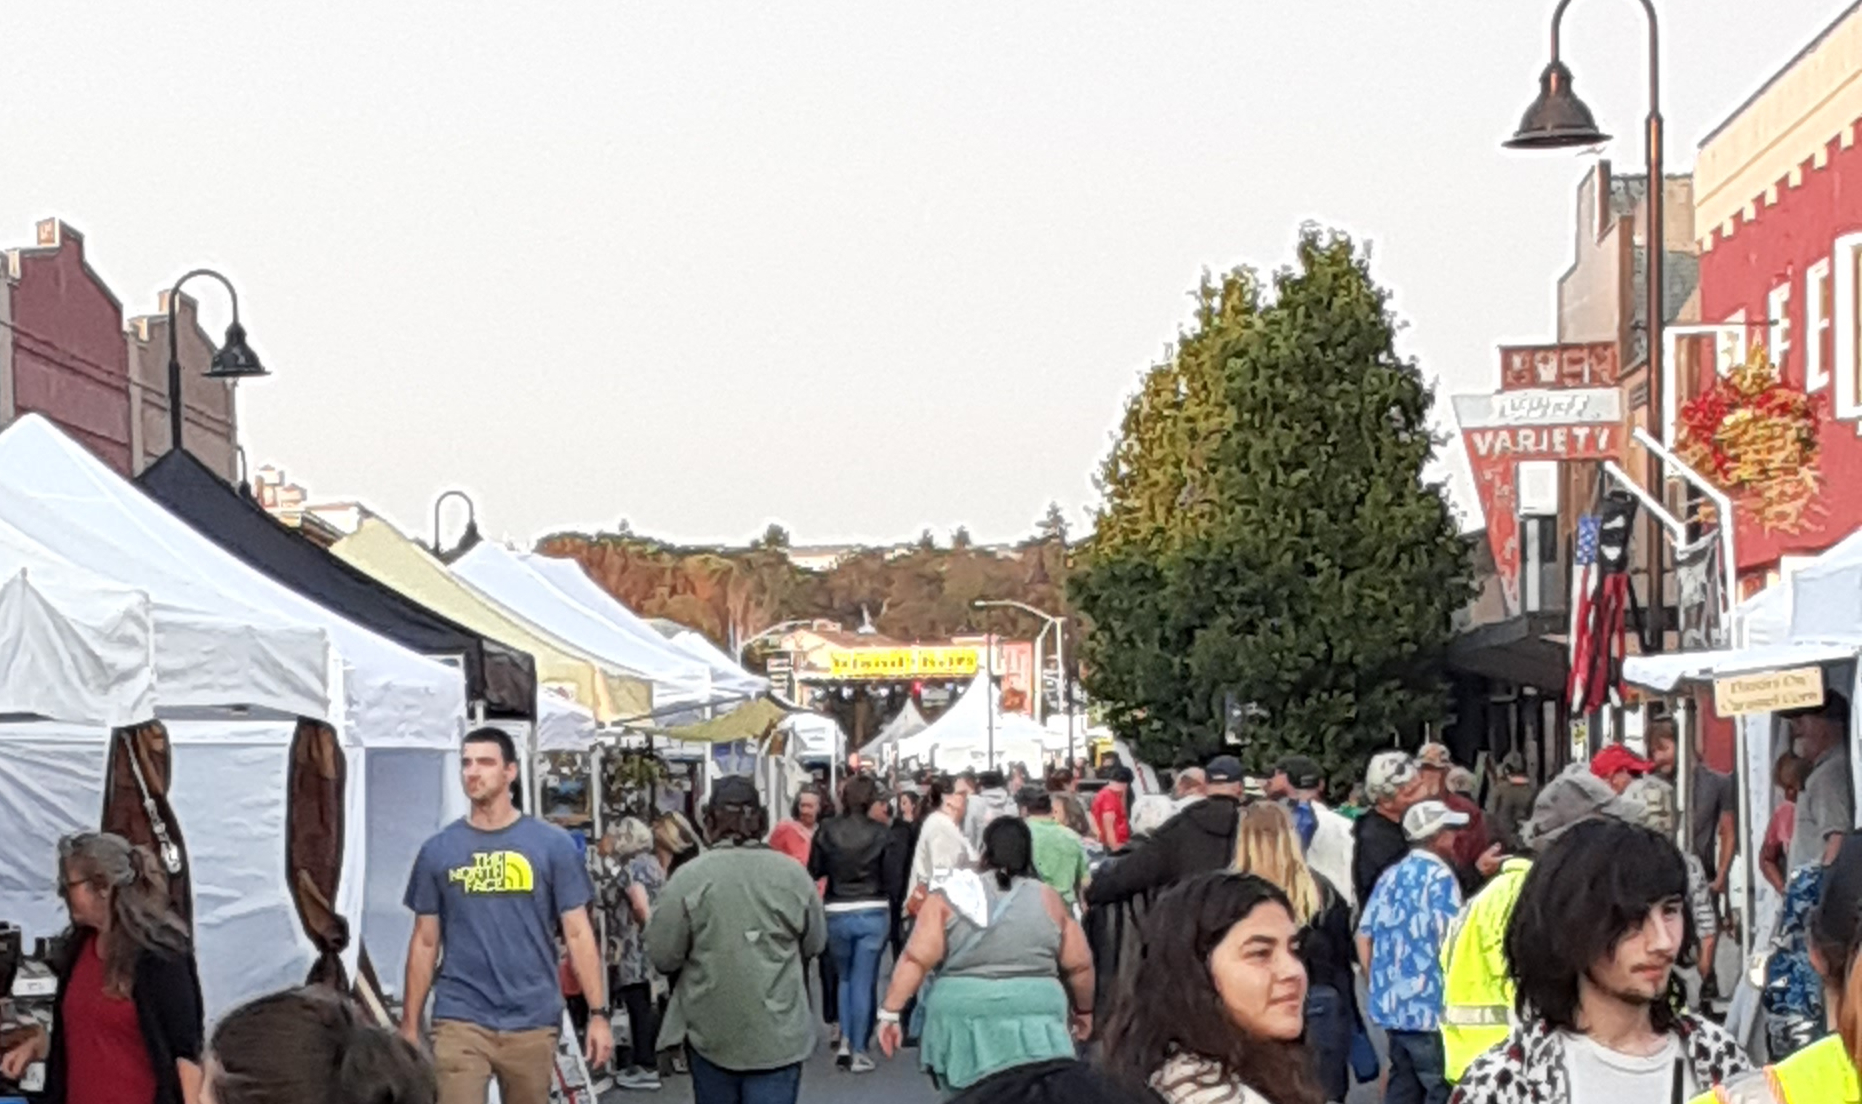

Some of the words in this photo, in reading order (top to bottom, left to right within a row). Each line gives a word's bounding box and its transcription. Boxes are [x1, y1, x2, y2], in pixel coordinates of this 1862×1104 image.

[1471, 427, 1611, 457] VARIETY
[472, 852, 504, 867] THE
[448, 866, 504, 882] NORTH
[464, 879, 505, 894] FACE
